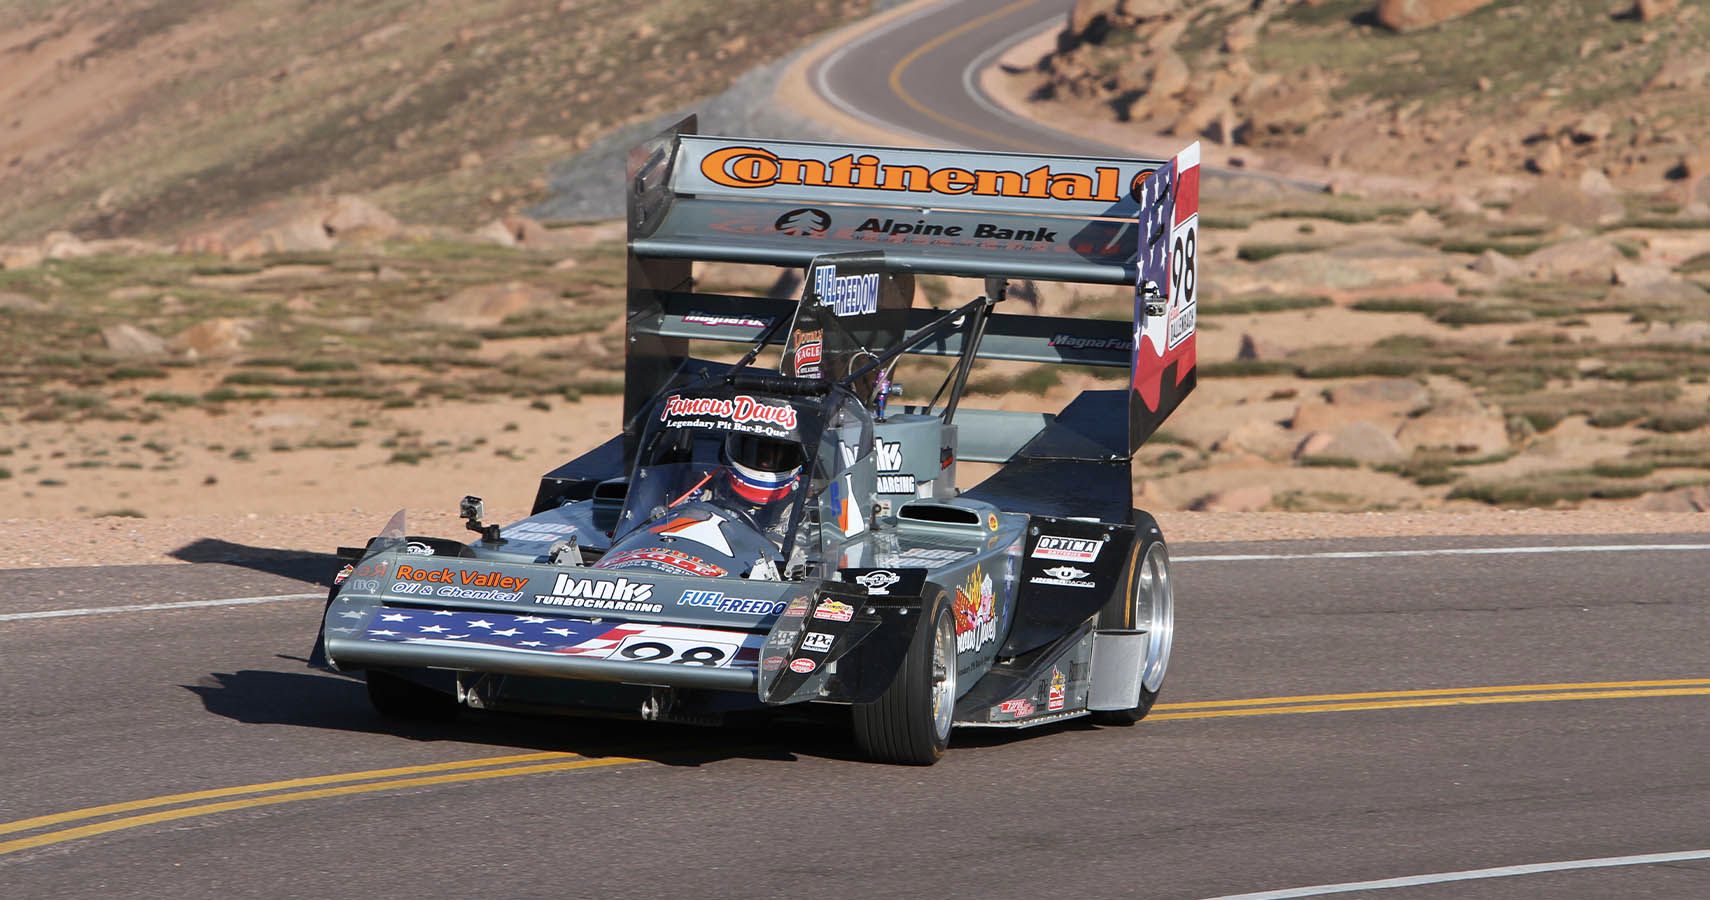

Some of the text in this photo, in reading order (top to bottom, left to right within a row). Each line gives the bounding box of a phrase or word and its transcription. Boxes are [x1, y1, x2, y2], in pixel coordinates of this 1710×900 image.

[700, 146, 1121, 202] Continental
[855, 218, 963, 238] Alpine
[974, 223, 1057, 243] Bank
[1172, 227, 1195, 308] 98
[832, 273, 880, 317] FREEDOM
[796, 346, 821, 363] EAGLE
[1050, 334, 1136, 350] MagnaFue
[660, 395, 798, 430] Famous Dave's
[666, 419, 716, 430] Legendary
[716, 420, 732, 430] Pit
[1039, 537, 1095, 552] OPTIMA
[396, 565, 456, 584] Rock
[460, 569, 529, 592] Valley
[552, 573, 655, 602] banks
[391, 582, 421, 594] Oil
[419, 585, 433, 595] &
[437, 586, 523, 602] Chemical
[534, 595, 664, 613] TURBOCHARGING
[677, 589, 725, 607] FUEL
[716, 597, 788, 615] FREEDO
